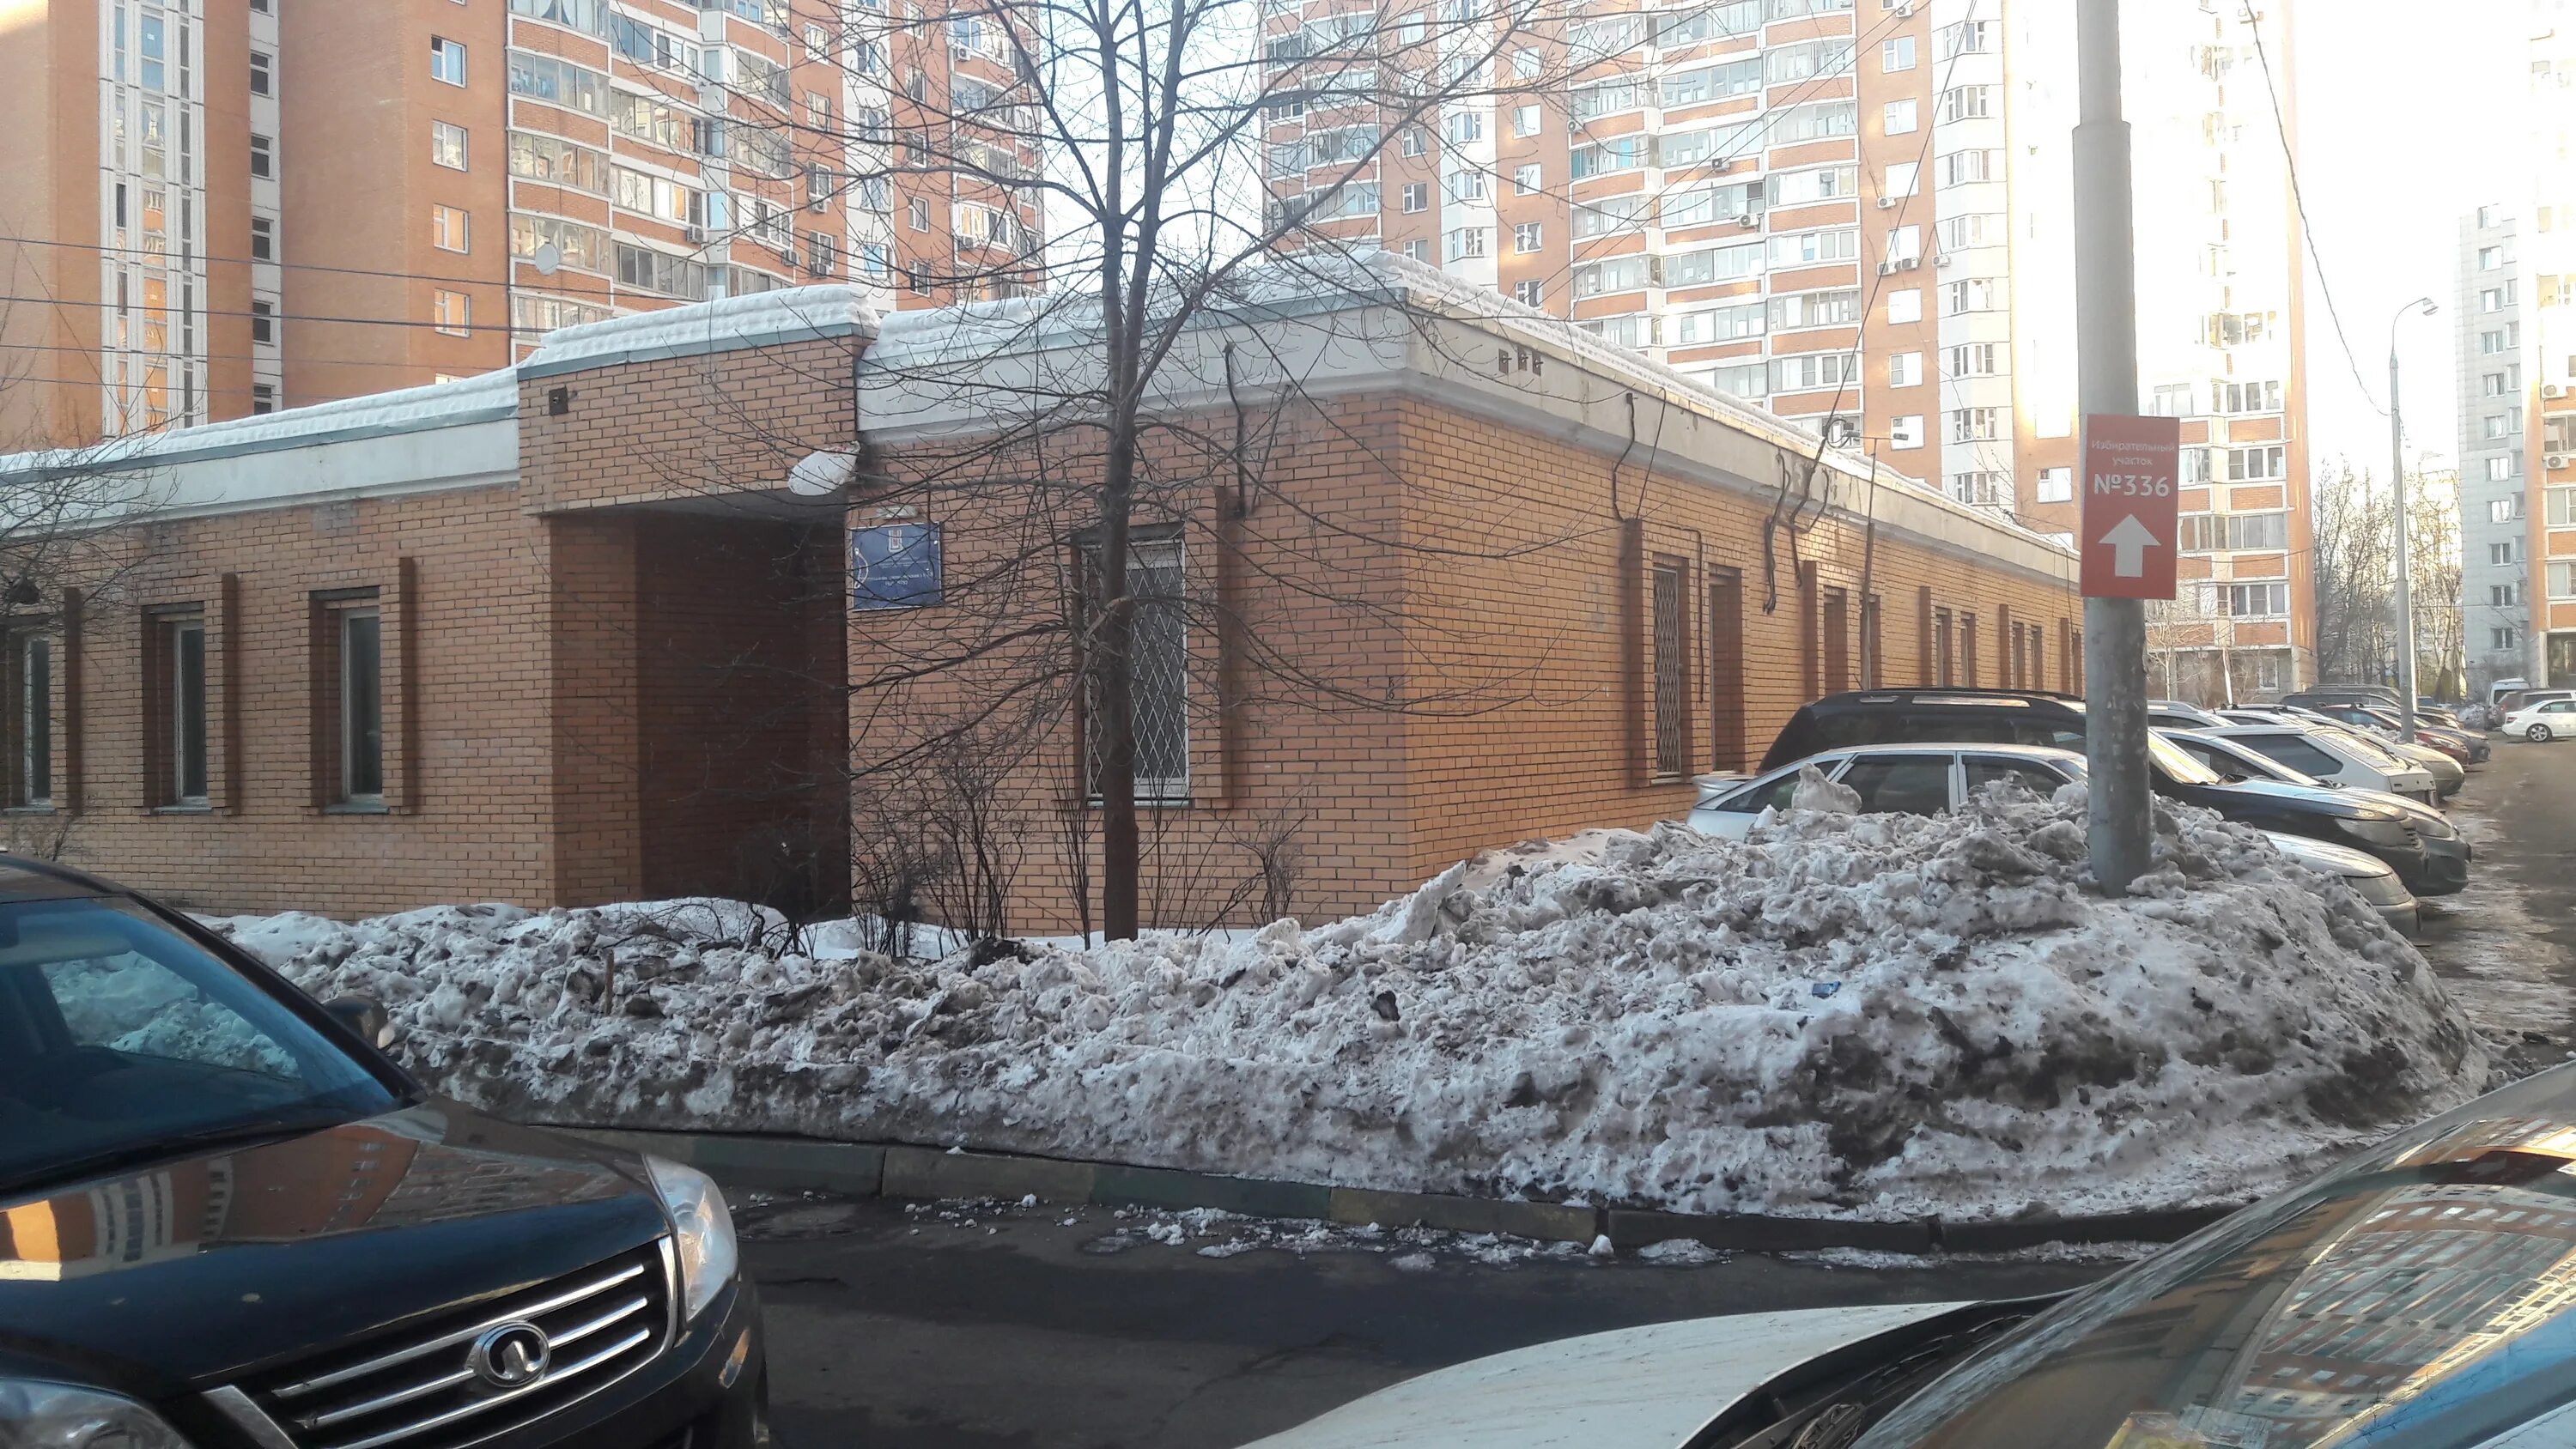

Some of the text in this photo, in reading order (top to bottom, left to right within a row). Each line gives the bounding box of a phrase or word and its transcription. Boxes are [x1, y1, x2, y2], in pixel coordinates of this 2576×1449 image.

[2091, 439, 2176, 452] Избирательный
[2112, 455, 2154, 466] участок
[2093, 473, 2171, 498] №336
